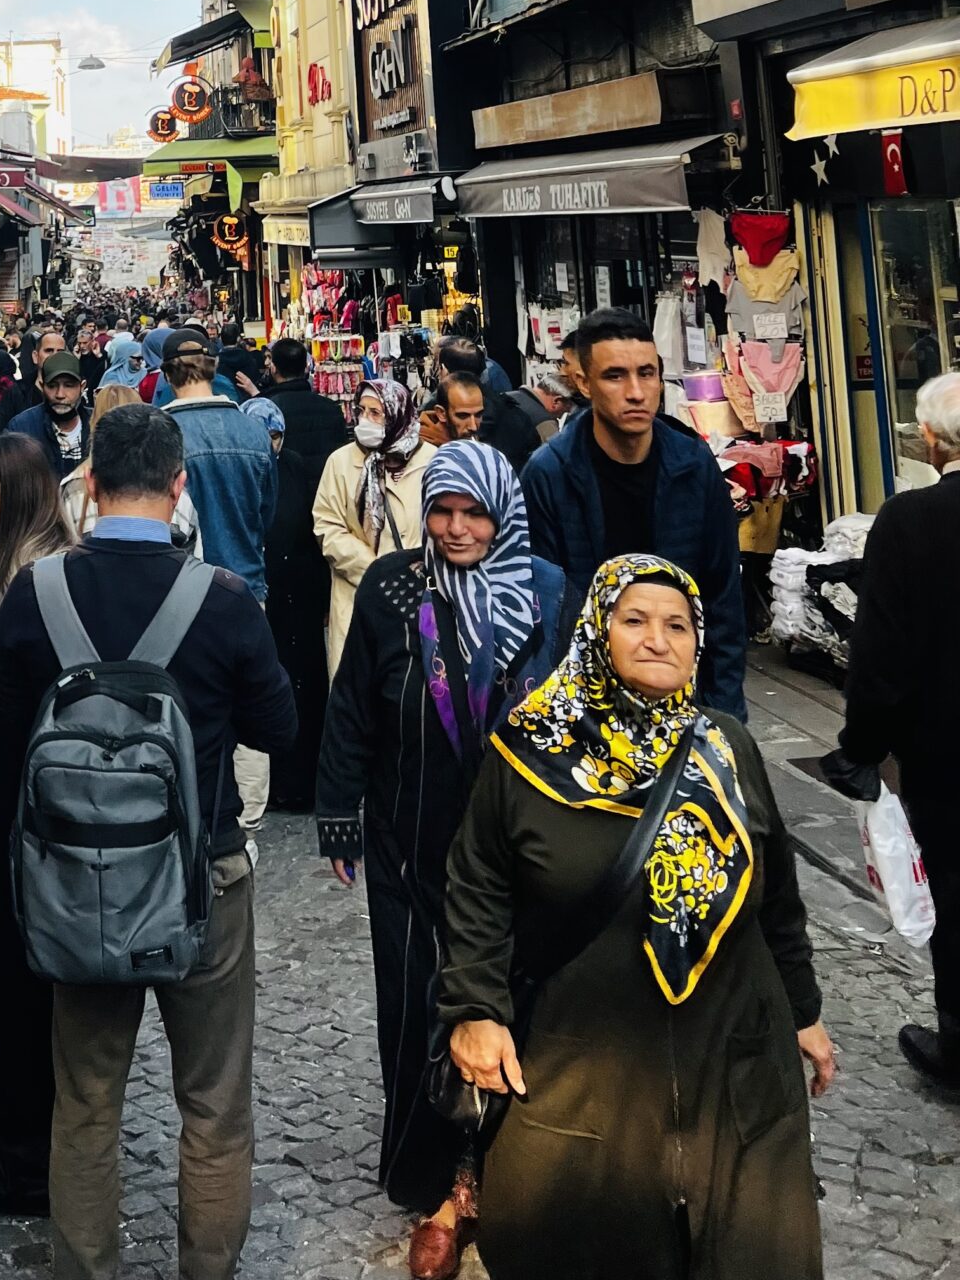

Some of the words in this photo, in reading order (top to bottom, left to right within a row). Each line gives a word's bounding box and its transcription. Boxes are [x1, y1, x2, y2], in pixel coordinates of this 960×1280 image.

[897, 67, 957, 119] D&P
[549, 178, 610, 210] TUHAFİYE
[446, 248, 455, 257] 15
